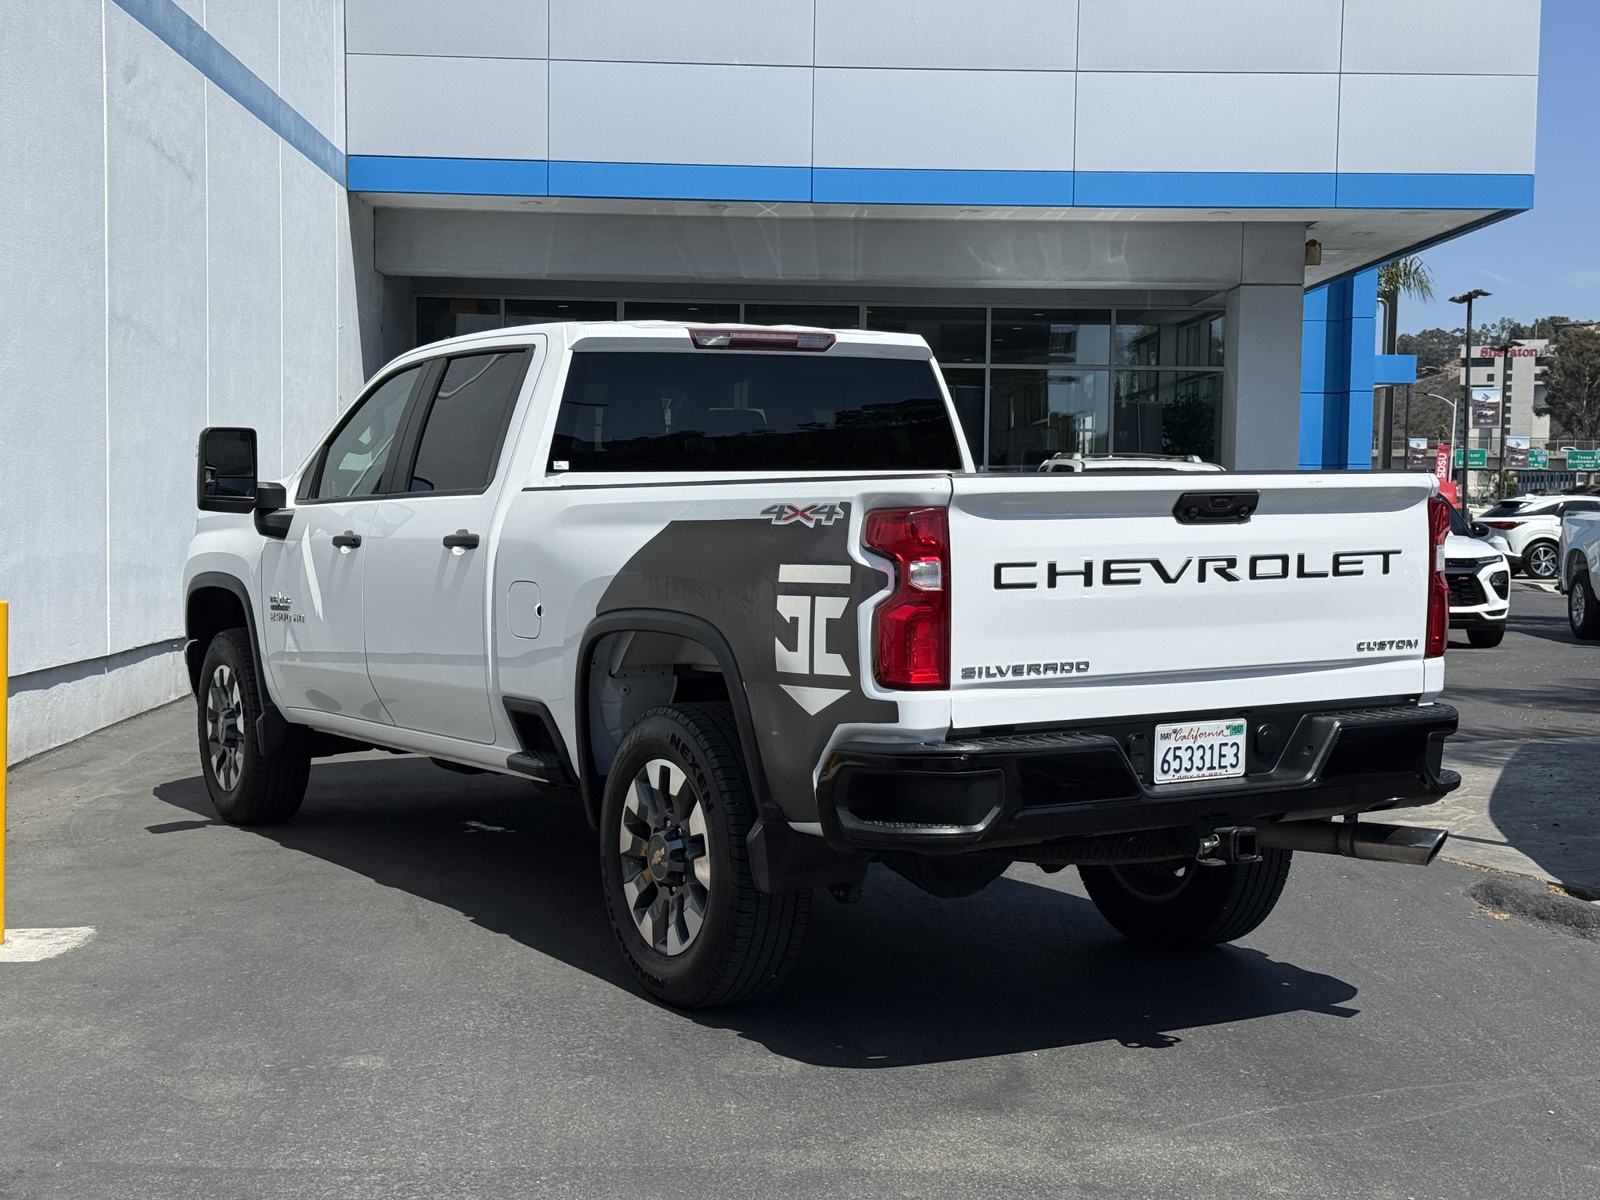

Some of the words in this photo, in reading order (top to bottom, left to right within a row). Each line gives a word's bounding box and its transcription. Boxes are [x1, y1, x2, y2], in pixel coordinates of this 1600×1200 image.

[1480, 347, 1538, 357] Sheaton
[1437, 453, 1447, 479] SDSU
[993, 549, 1402, 590] CHEVROLET
[1356, 638, 1419, 652] CUSTOM
[961, 660, 1090, 680] SILVERADO
[1160, 732, 1172, 741] MAY
[1174, 727, 1229, 744] California
[1160, 741, 1240, 775] 65331E3
[670, 732, 714, 814] NEXEN
